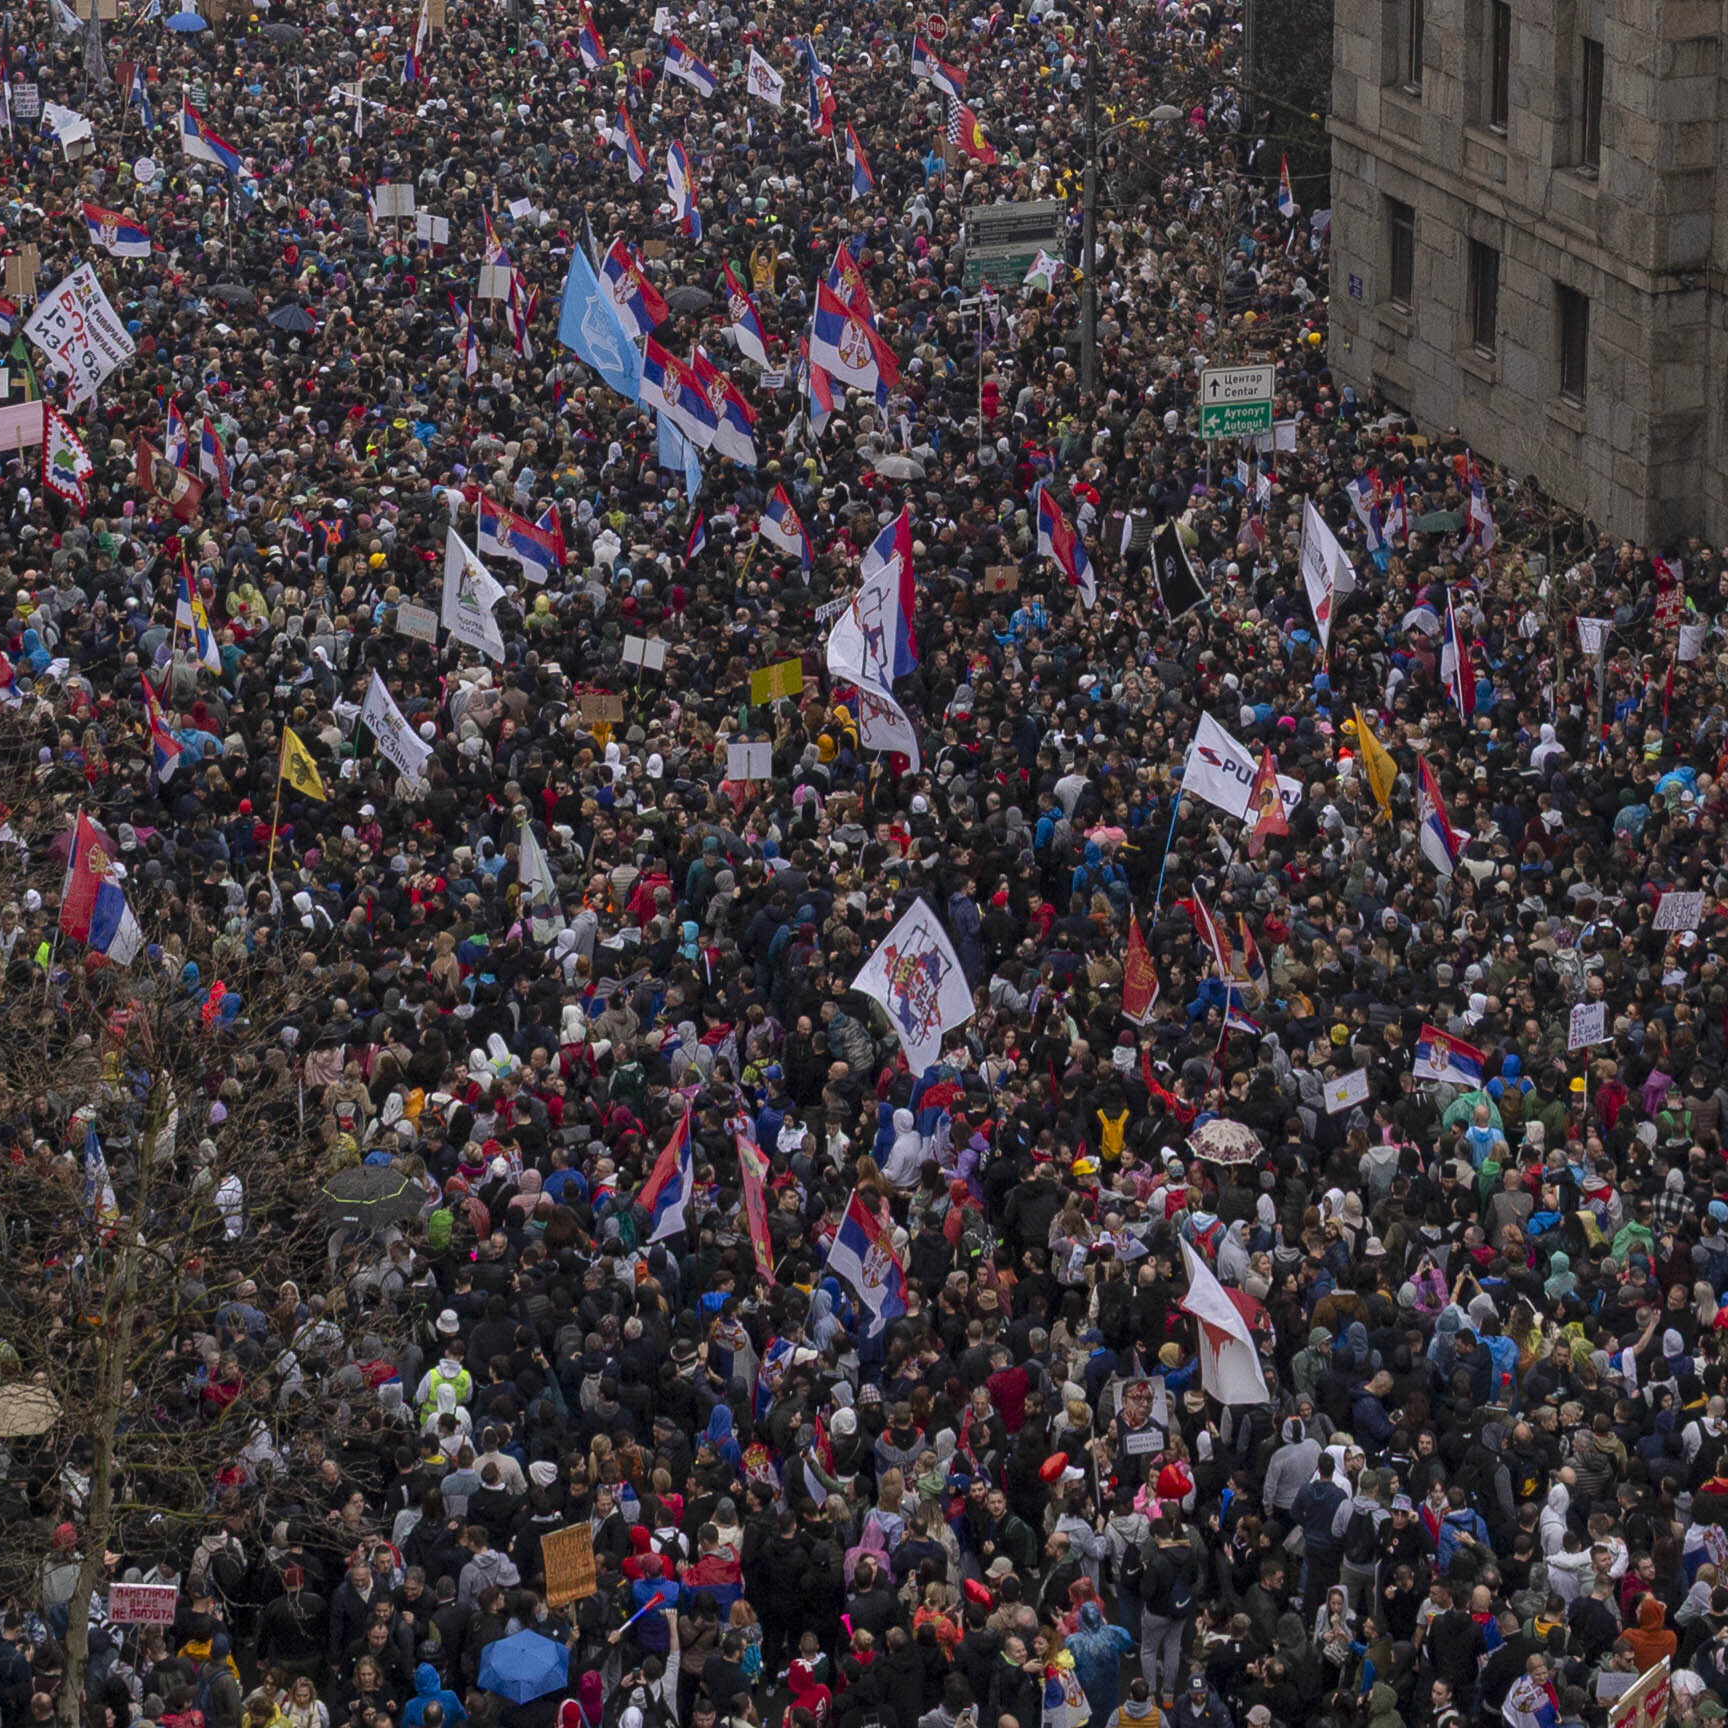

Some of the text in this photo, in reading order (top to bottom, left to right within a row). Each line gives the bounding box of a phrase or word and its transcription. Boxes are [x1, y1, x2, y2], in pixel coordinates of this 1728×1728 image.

[929, 21, 945, 33] STOP
[1224, 375, 1262, 386] Центар
[1224, 387, 1258, 397] Centar
[1223, 406, 1266, 420] Аутопут
[1223, 419, 1264, 433] Autoput
[1222, 758, 1301, 806] PUAJ
[112, 1608, 125, 1619] НЕ
